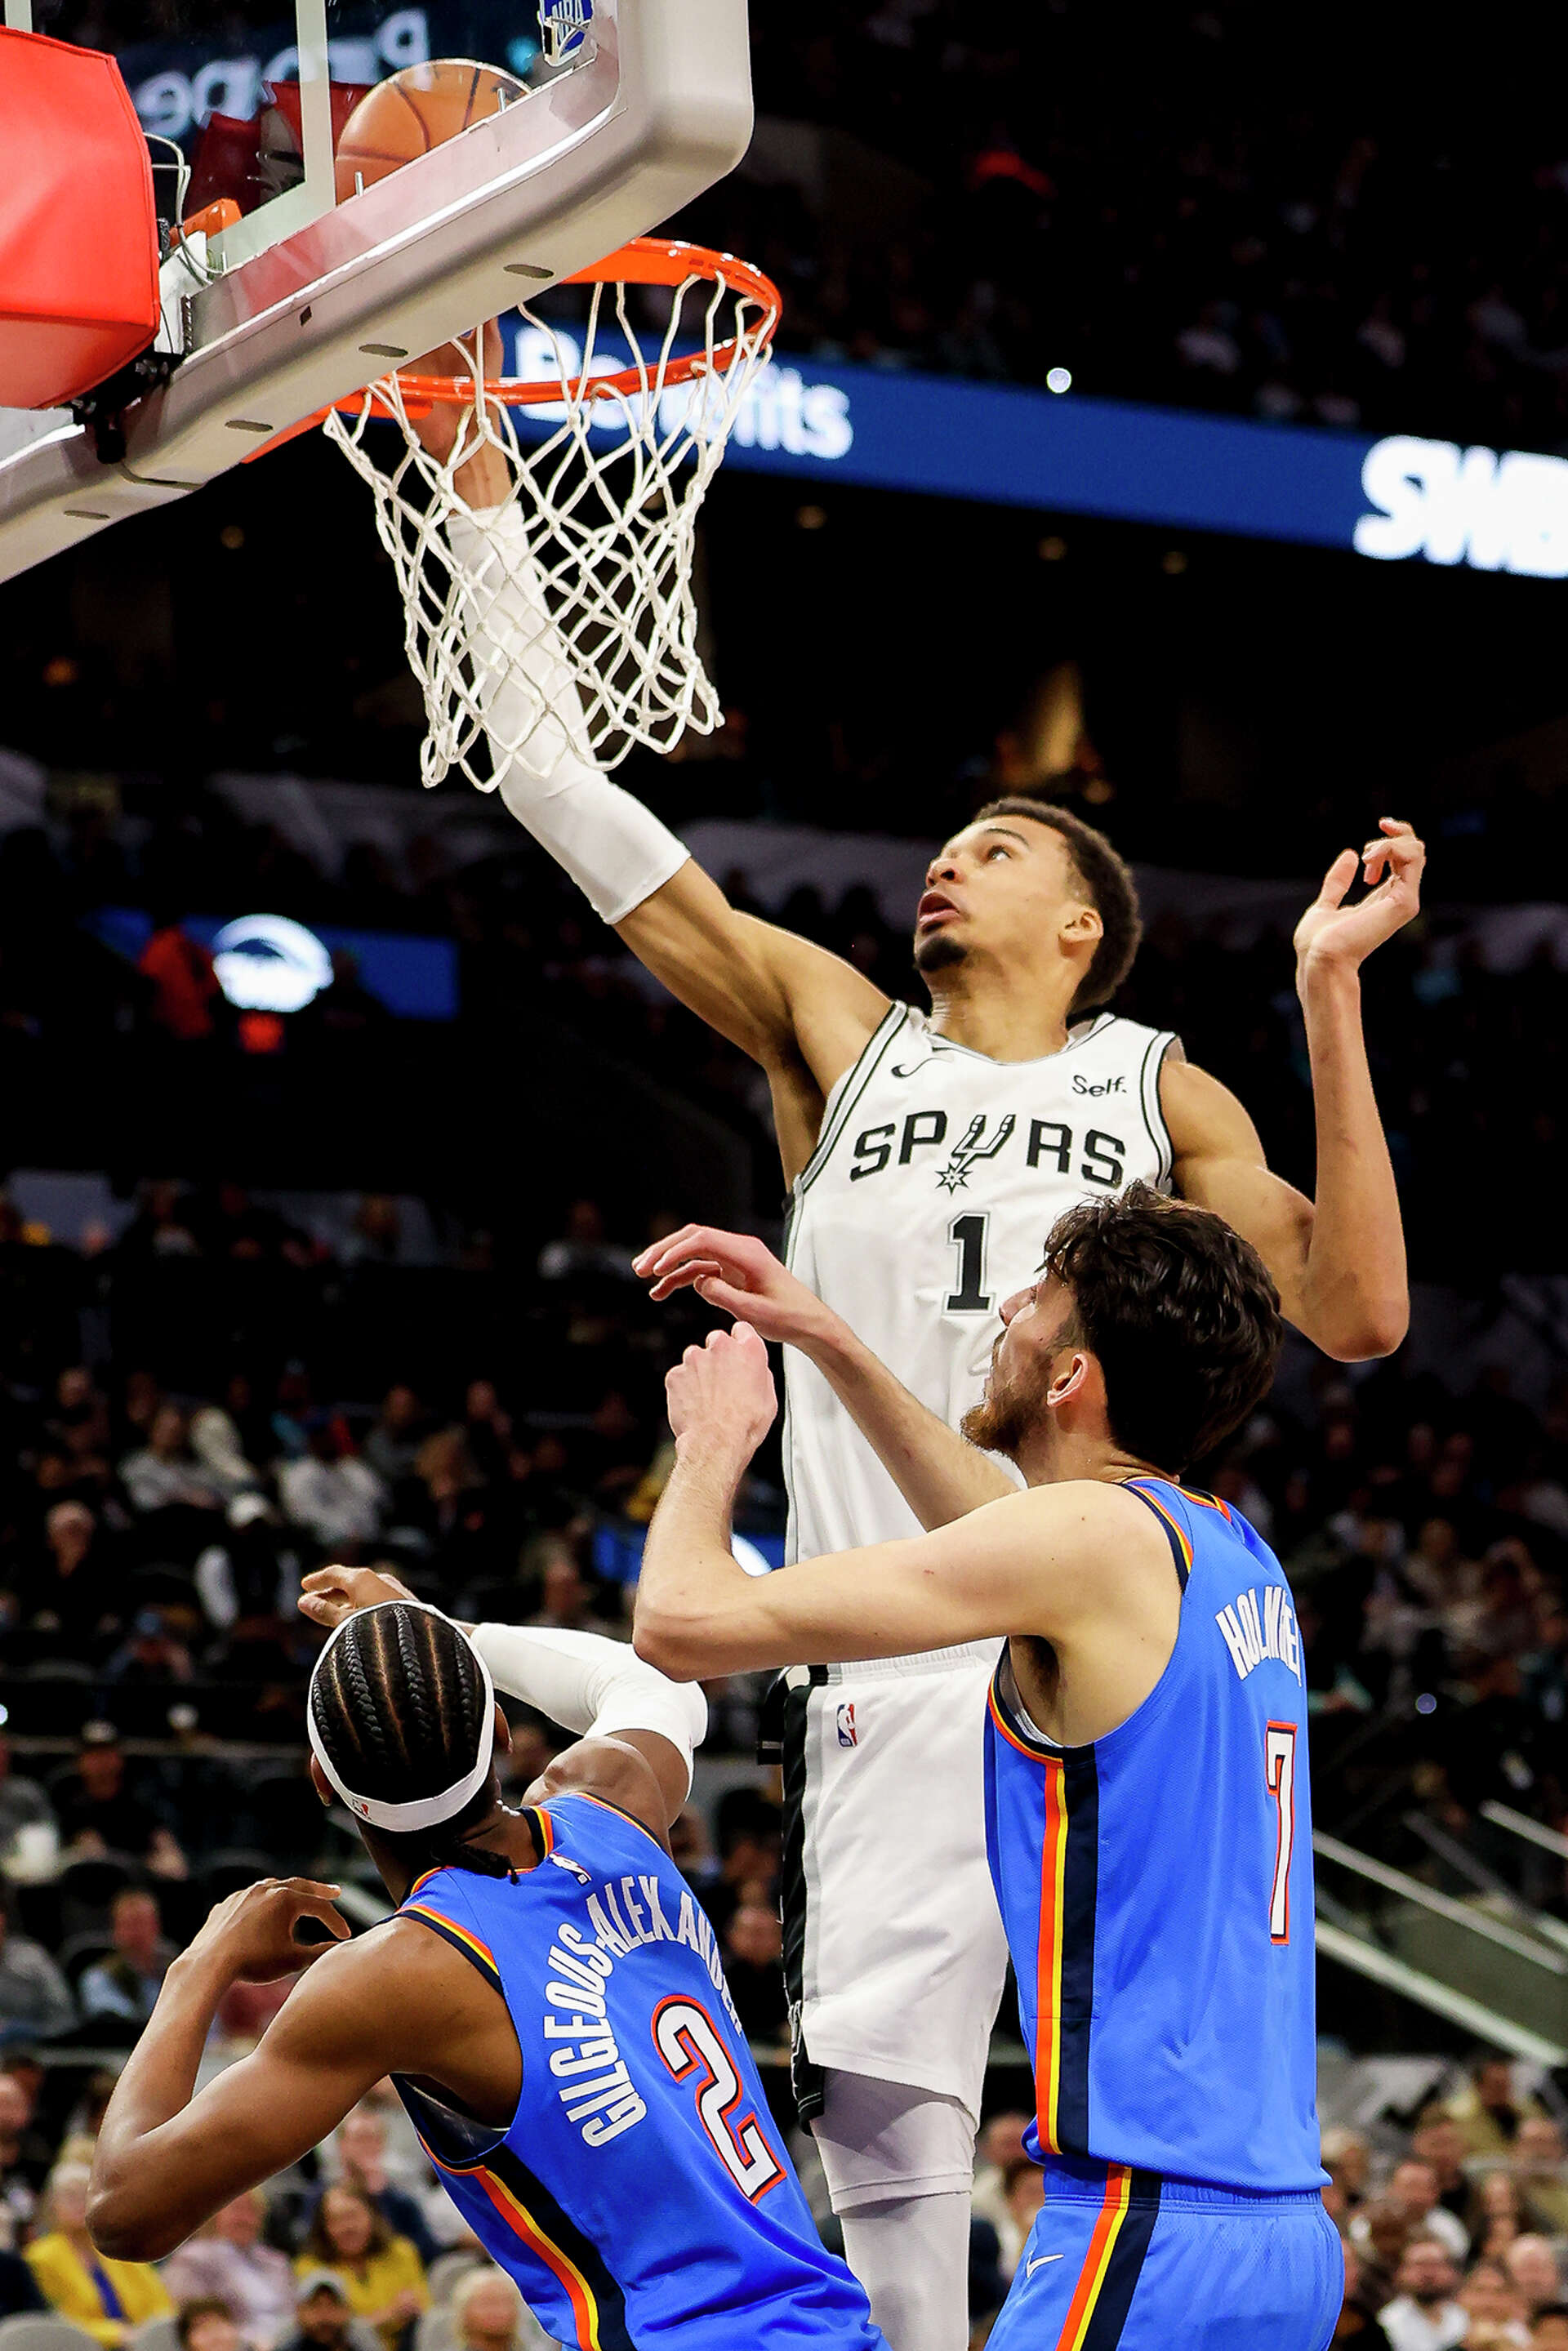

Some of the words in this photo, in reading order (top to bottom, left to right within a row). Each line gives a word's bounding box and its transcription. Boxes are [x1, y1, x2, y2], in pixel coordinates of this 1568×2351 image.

[1071, 1074, 1127, 1097] Self.
[849, 1110, 1126, 1195] SPURS
[942, 1209, 997, 1316] 1
[1214, 1585, 1302, 1688] HOLME
[1266, 1720, 1298, 1946] 7
[650, 1994, 787, 2205] 2
